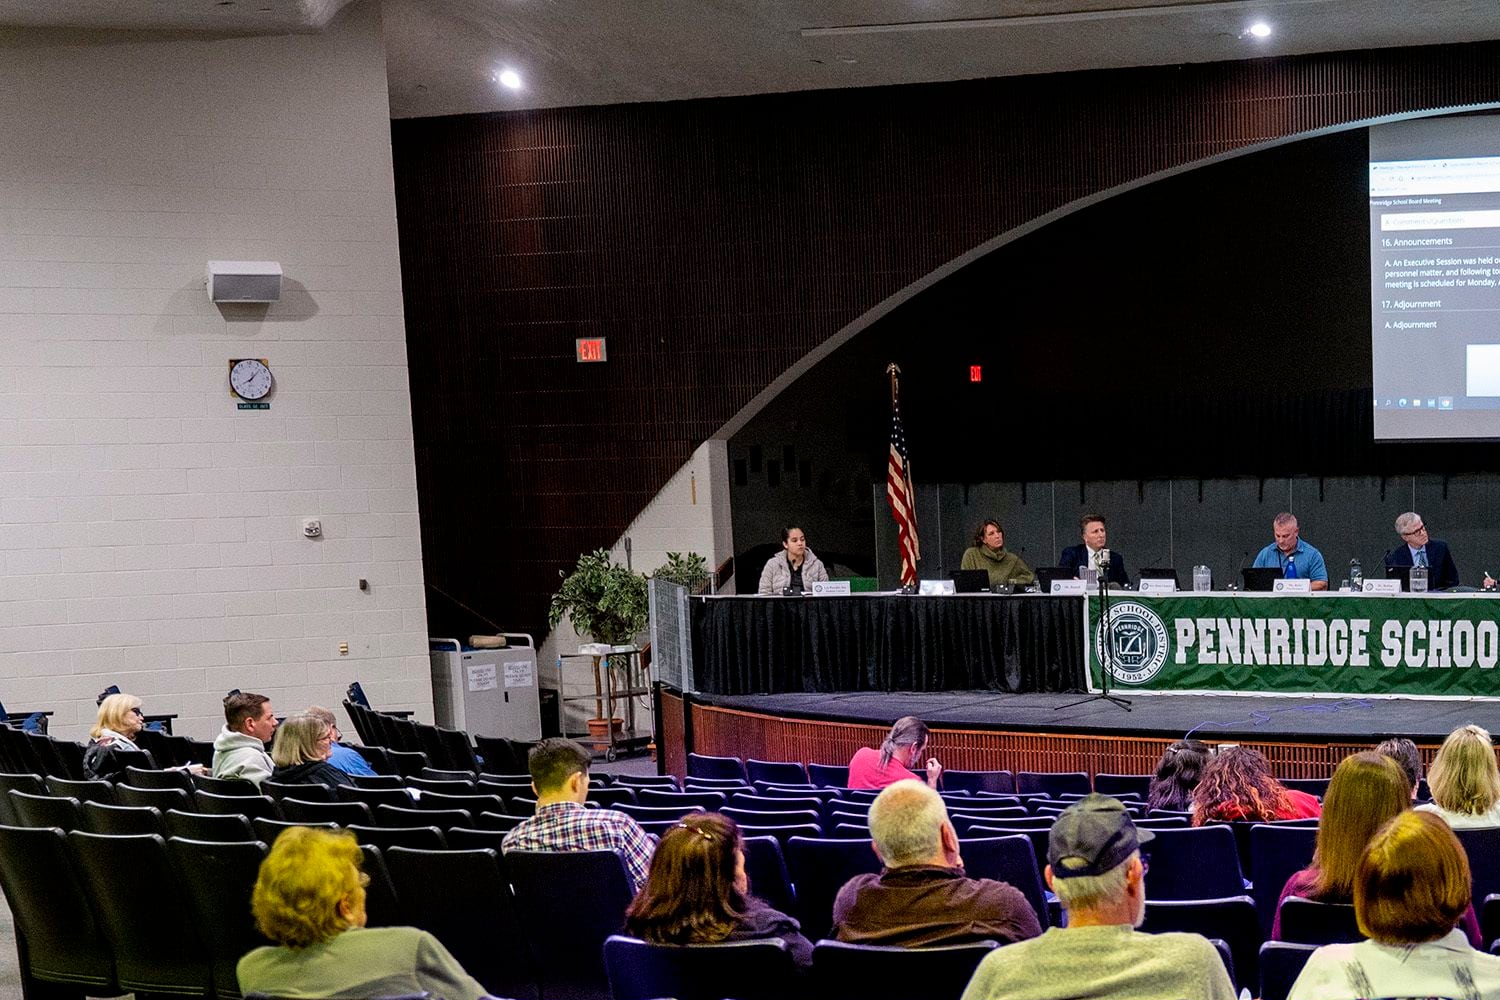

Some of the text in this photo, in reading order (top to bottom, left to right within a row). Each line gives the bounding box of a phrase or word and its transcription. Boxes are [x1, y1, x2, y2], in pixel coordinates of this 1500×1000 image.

[1381, 237, 1453, 247] 16. Announcements
[1393, 259, 1402, 267] An
[1404, 259, 1435, 267] Executive
[1436, 258, 1462, 266] Session
[1385, 270, 1418, 279] personnel
[1460, 268, 1491, 277] following
[1385, 281, 1412, 289] meeting
[1420, 279, 1454, 287] scheduled
[1467, 278, 1496, 288] Monday,
[1394, 300, 1441, 310] Adjournment
[1393, 321, 1437, 330] Adjournment
[581, 341, 601, 360] EXIT
[1115, 624, 1144, 633] PENNRIDGE
[1114, 605, 1166, 673] SCHOOL DISTRICT
[1175, 618, 1370, 666] PENNRIDGE
